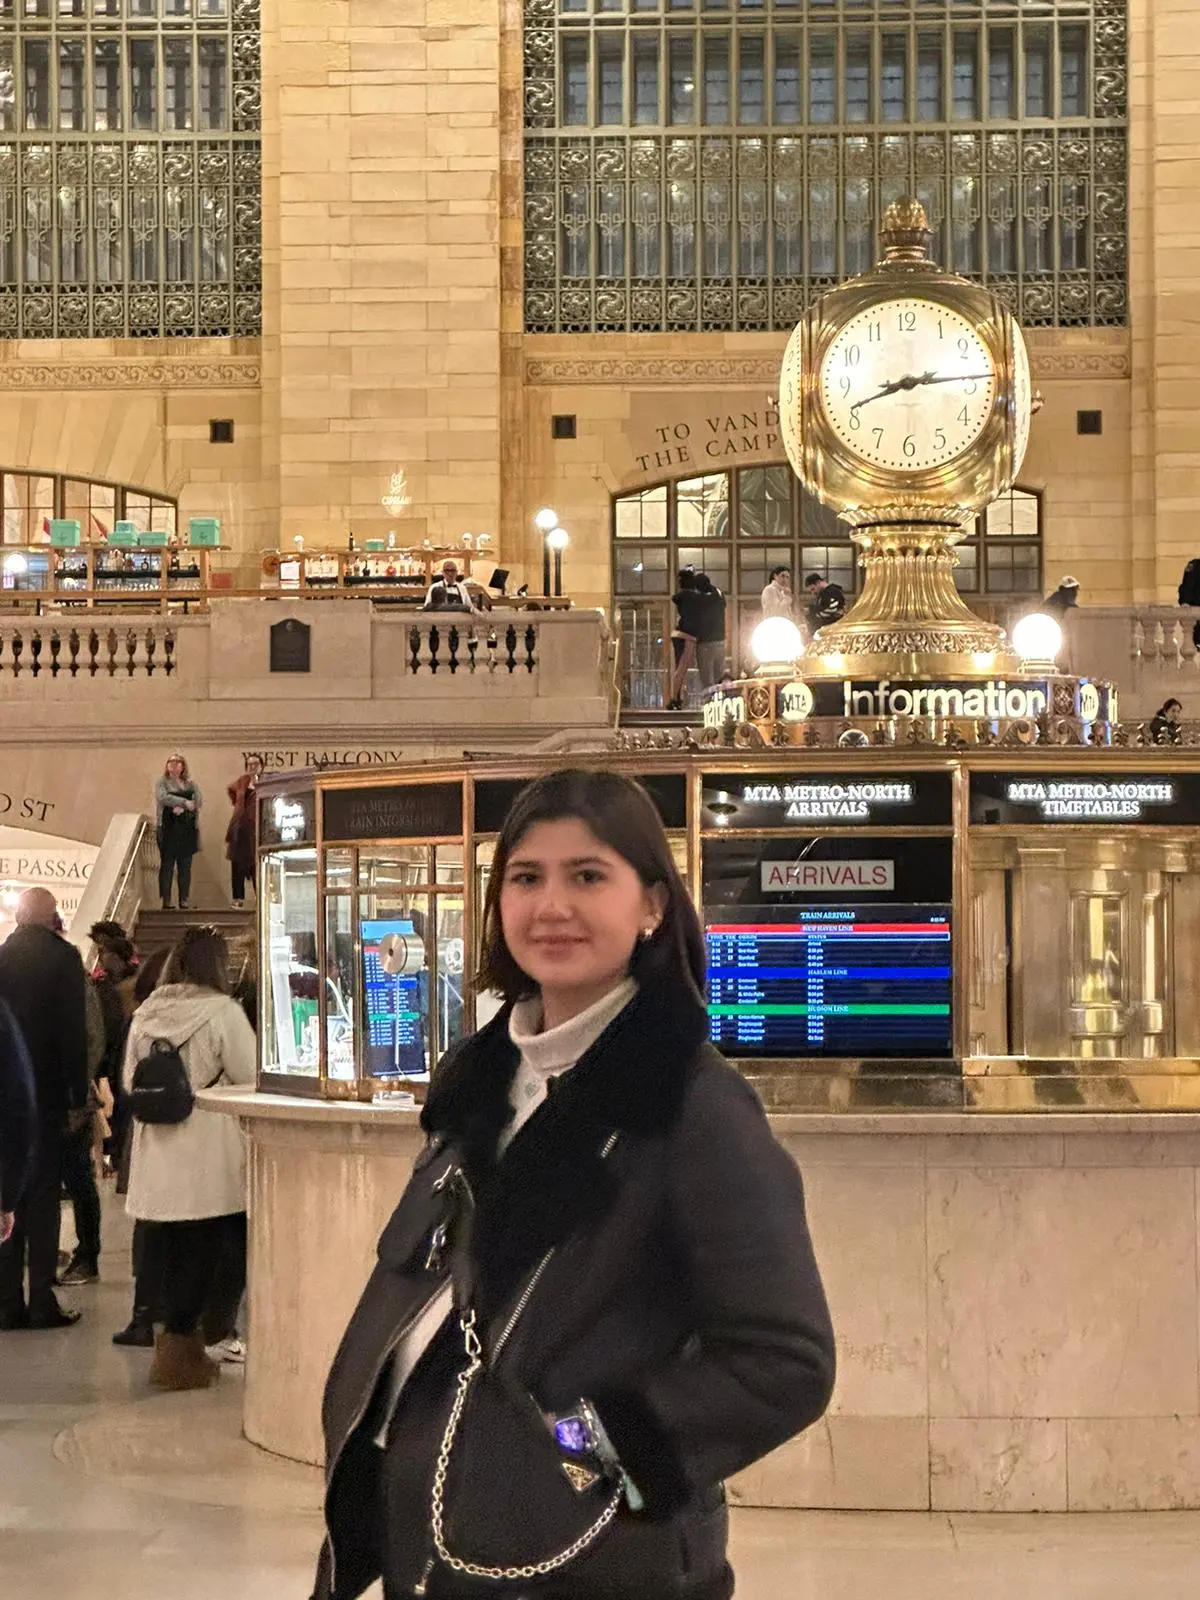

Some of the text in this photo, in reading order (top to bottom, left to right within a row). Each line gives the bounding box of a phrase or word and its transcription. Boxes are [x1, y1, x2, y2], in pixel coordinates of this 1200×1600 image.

[868, 321, 881, 342] 11
[898, 312, 916, 331] 12
[937, 320, 943, 339] 1
[844, 345, 860, 366] 10
[957, 339, 968, 359] 2
[839, 376, 850, 398] 9
[849, 406, 861, 430] 8
[956, 404, 971, 426] 4
[656, 411, 780, 443] TO VAND
[872, 428, 884, 449] 7
[903, 434, 916, 457] 6
[933, 428, 946, 449] 5
[636, 433, 778, 471] THE CAMP
[782, 692, 807, 712] MTA
[844, 681, 1046, 718] Information
[744, 785, 911, 800] MTA METRO-NORTH
[1009, 784, 1173, 800] MTA METRO-NORTH
[20, 798, 55, 822] ST
[787, 801, 868, 816] ARRIVALS
[1042, 800, 1140, 815] TIMETABLES
[768, 865, 888, 885] ARRIVALS
